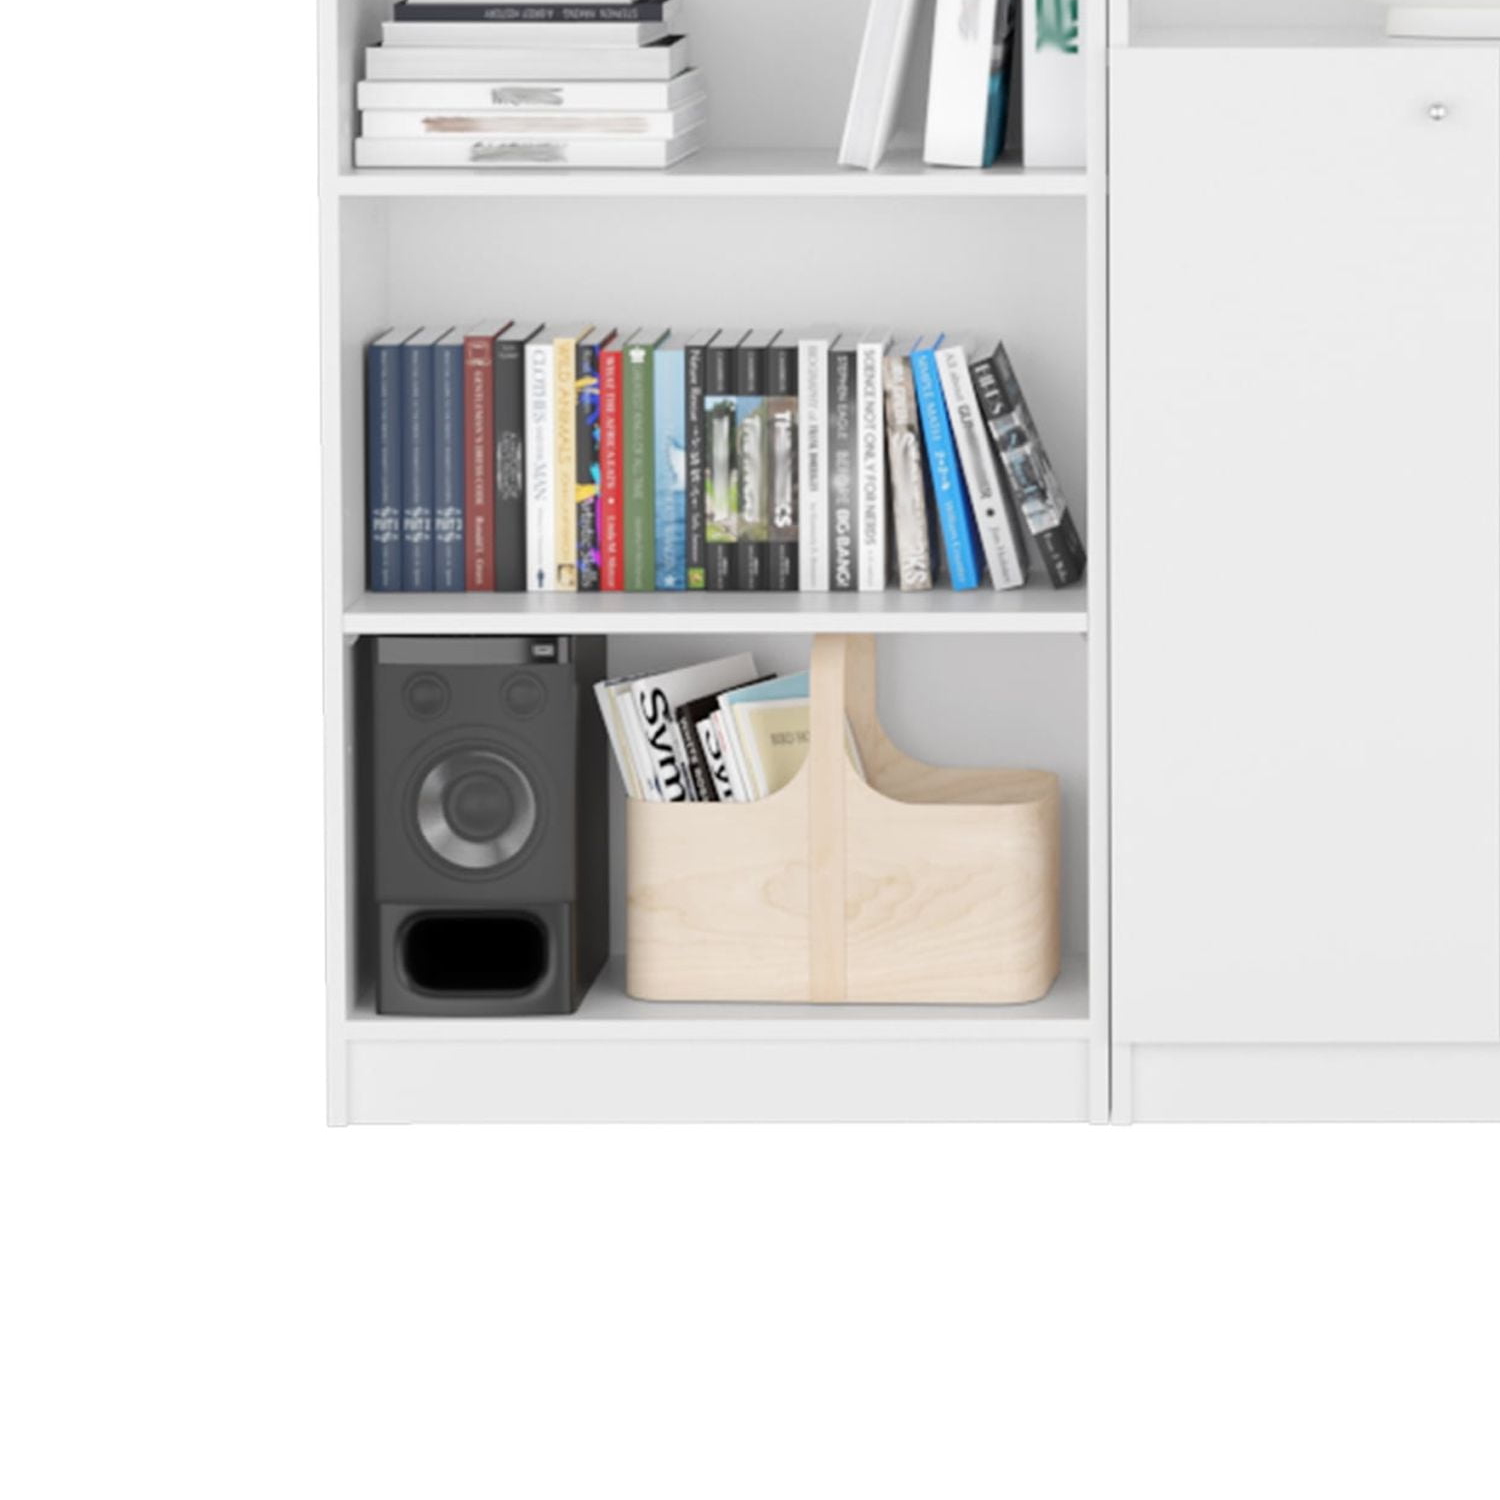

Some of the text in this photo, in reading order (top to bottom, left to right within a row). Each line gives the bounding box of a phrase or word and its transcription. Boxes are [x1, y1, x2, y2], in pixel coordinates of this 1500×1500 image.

[558, 343, 571, 385] WILD
[558, 389, 571, 465] ANIMALS
[864, 349, 877, 546] SCIENCE NOT ONLY FOR NERDS
[532, 461, 548, 501] MAN
[836, 508, 850, 534] BIG
